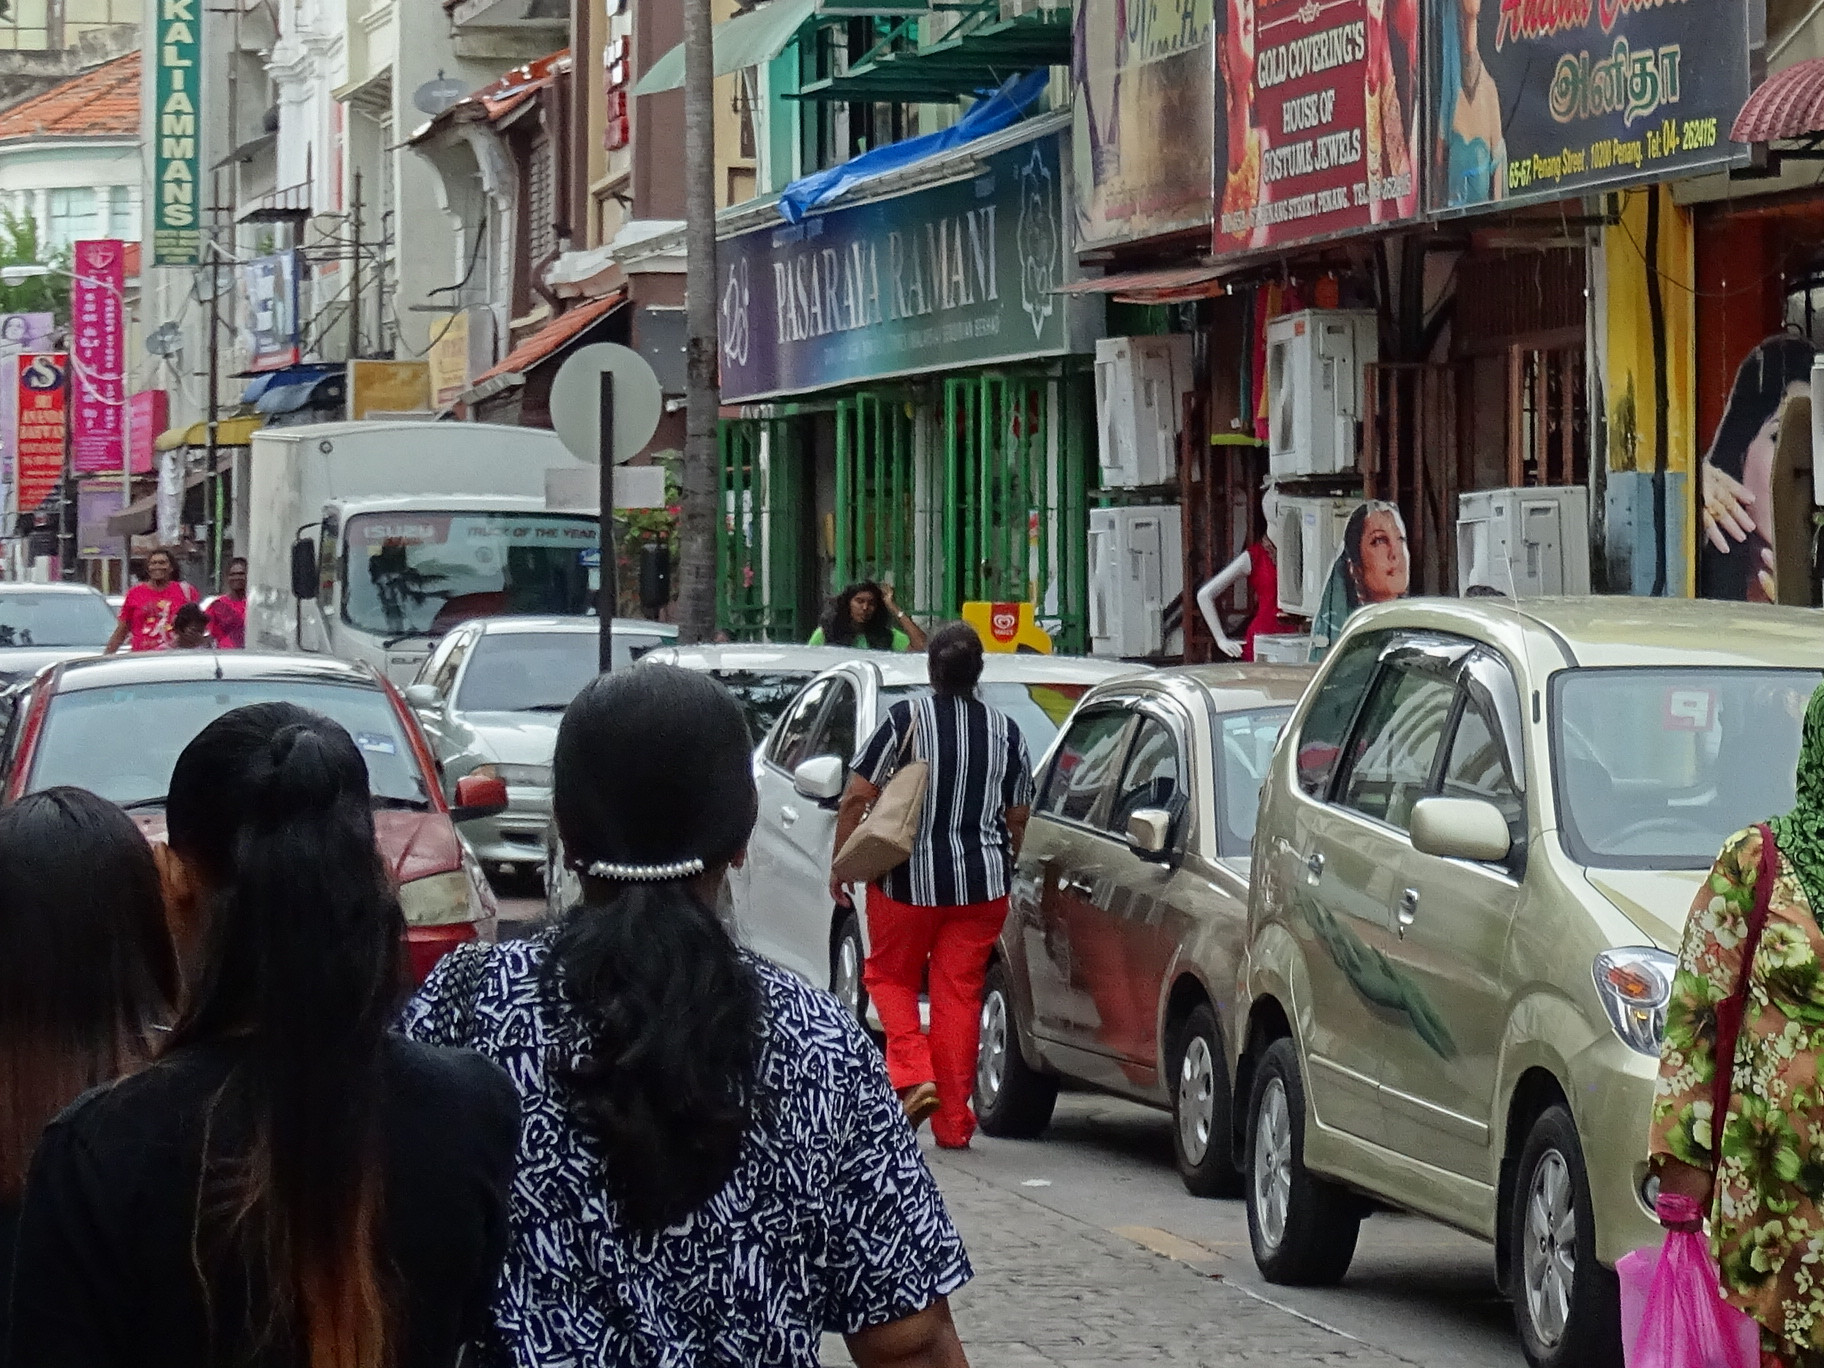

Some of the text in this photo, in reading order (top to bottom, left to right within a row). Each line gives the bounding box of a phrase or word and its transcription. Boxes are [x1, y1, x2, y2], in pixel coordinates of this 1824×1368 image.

[1258, 21, 1365, 89] GOLD COVERING'S
[1549, 34, 1681, 128] அனிதா
[1282, 88, 1336, 134] HOUSE OF
[1263, 127, 1361, 184] COSTUME JEWELS
[772, 240, 882, 345] PASARAYA
